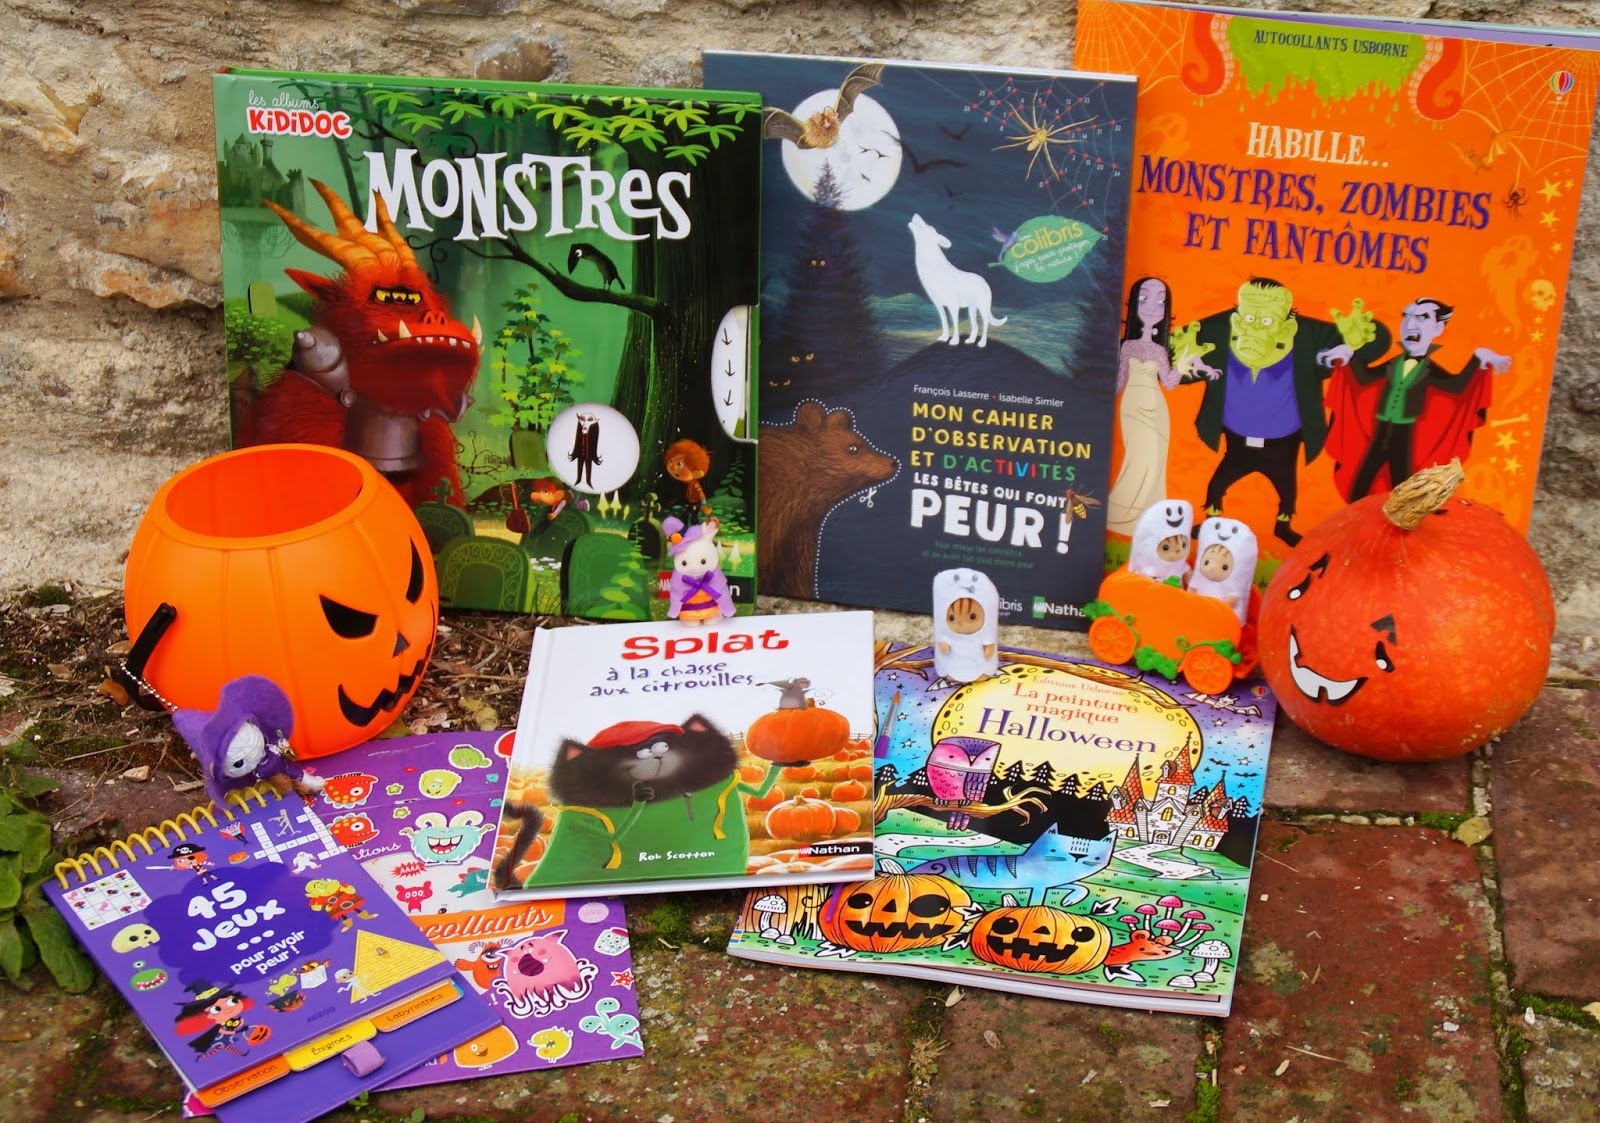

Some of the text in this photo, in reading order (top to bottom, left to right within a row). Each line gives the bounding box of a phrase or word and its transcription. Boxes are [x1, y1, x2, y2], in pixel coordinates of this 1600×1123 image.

[1253, 29, 1409, 59] AUTOCOLLANTS USBORNE
[249, 90, 319, 109] les albums
[1246, 121, 1389, 168] HABILLE...
[1136, 154, 1492, 231] MONSTRES, ZOMBIES
[1011, 219, 1084, 259] colibris
[1183, 211, 1430, 274] ET FANTÔMES
[914, 385, 1064, 407] François Lasserre Isabelle Simler
[912, 402, 1054, 430] MON CAHIER
[912, 427, 1091, 459] D'OBSERVATION
[911, 450, 1076, 481] ET D'ACTIVITÉS
[914, 472, 1067, 509] LES BÊTES QUI FONT
[910, 488, 1072, 554] PEUR !
[999, 597, 1023, 612] ibris
[1045, 602, 1087, 617] Natha
[621, 629, 789, 660] Splat
[590, 672, 753, 697] aux citrouilles
[606, 662, 727, 681] à la chasse
[1013, 682, 1139, 714] La peinture
[1026, 703, 1119, 725] magique
[976, 707, 1158, 753] Halloween
[352, 842, 402, 860] tions
[638, 849, 715, 862] Rob Scotton
[808, 844, 860, 856] Nathan
[400, 864, 420, 874] AAAA
[187, 881, 247, 919] 45
[192, 899, 286, 952] Jeux
[418, 906, 553, 940] collants
[230, 930, 305, 975] pour avoir
[255, 944, 301, 975] peur !
[386, 993, 444, 1021] Labyrinthes
[310, 1033, 353, 1056] Énigmes
[213, 1065, 276, 1096] Observation
